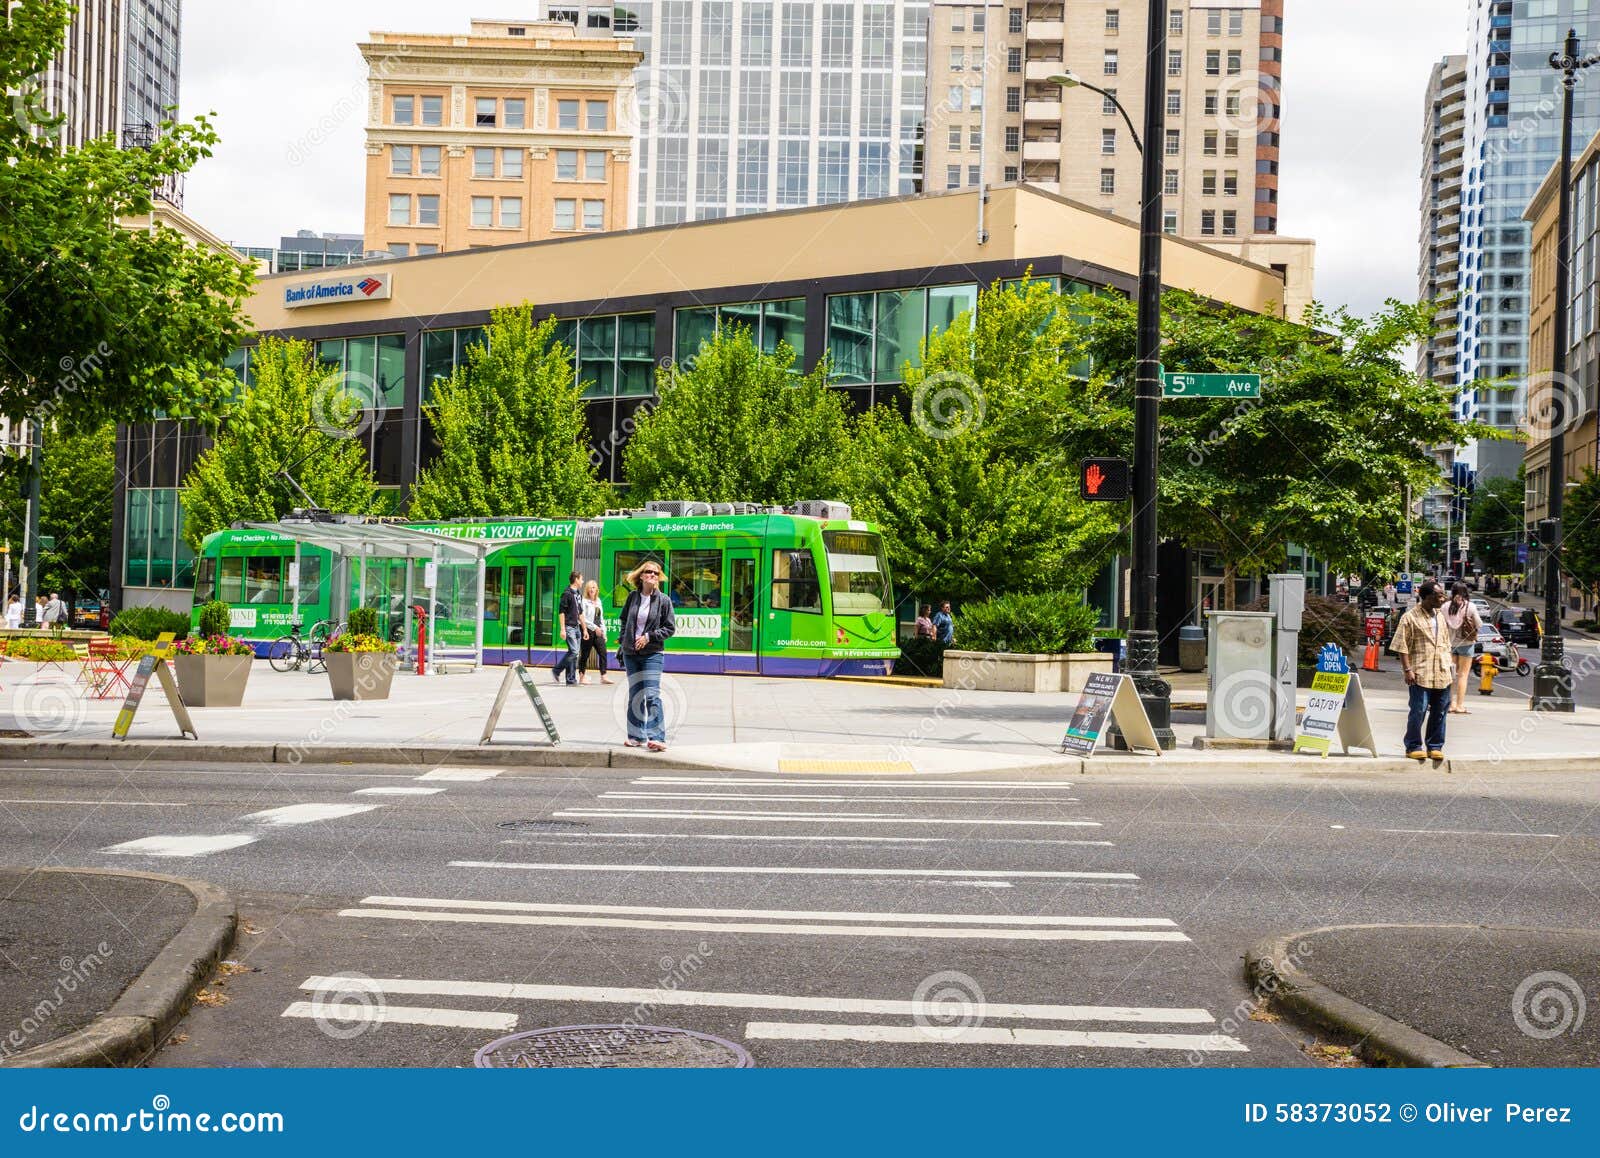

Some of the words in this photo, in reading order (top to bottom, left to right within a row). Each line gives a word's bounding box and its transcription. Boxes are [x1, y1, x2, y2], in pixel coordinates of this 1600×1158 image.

[286, 288, 305, 302] Bank
[306, 285, 315, 299] of
[315, 282, 353, 298] America
[1172, 375, 1195, 393] 5th
[1228, 380, 1251, 392] Ave
[465, 526, 487, 539] IT'S
[490, 525, 523, 538] YOUR
[527, 524, 573, 537] MONEY.
[647, 524, 655, 532] 21
[656, 523, 698, 532] Full-Service
[700, 522, 734, 530] Branches
[676, 616, 718, 629] OUND
[777, 639, 827, 647] soundcu.com
[1324, 652, 1339, 661] NOW
[1324, 662, 1341, 671] OPEN
[1317, 674, 1333, 682] BRAND
[1334, 676, 1345, 684] NEW
[1314, 683, 1345, 692] APARTMENTS
